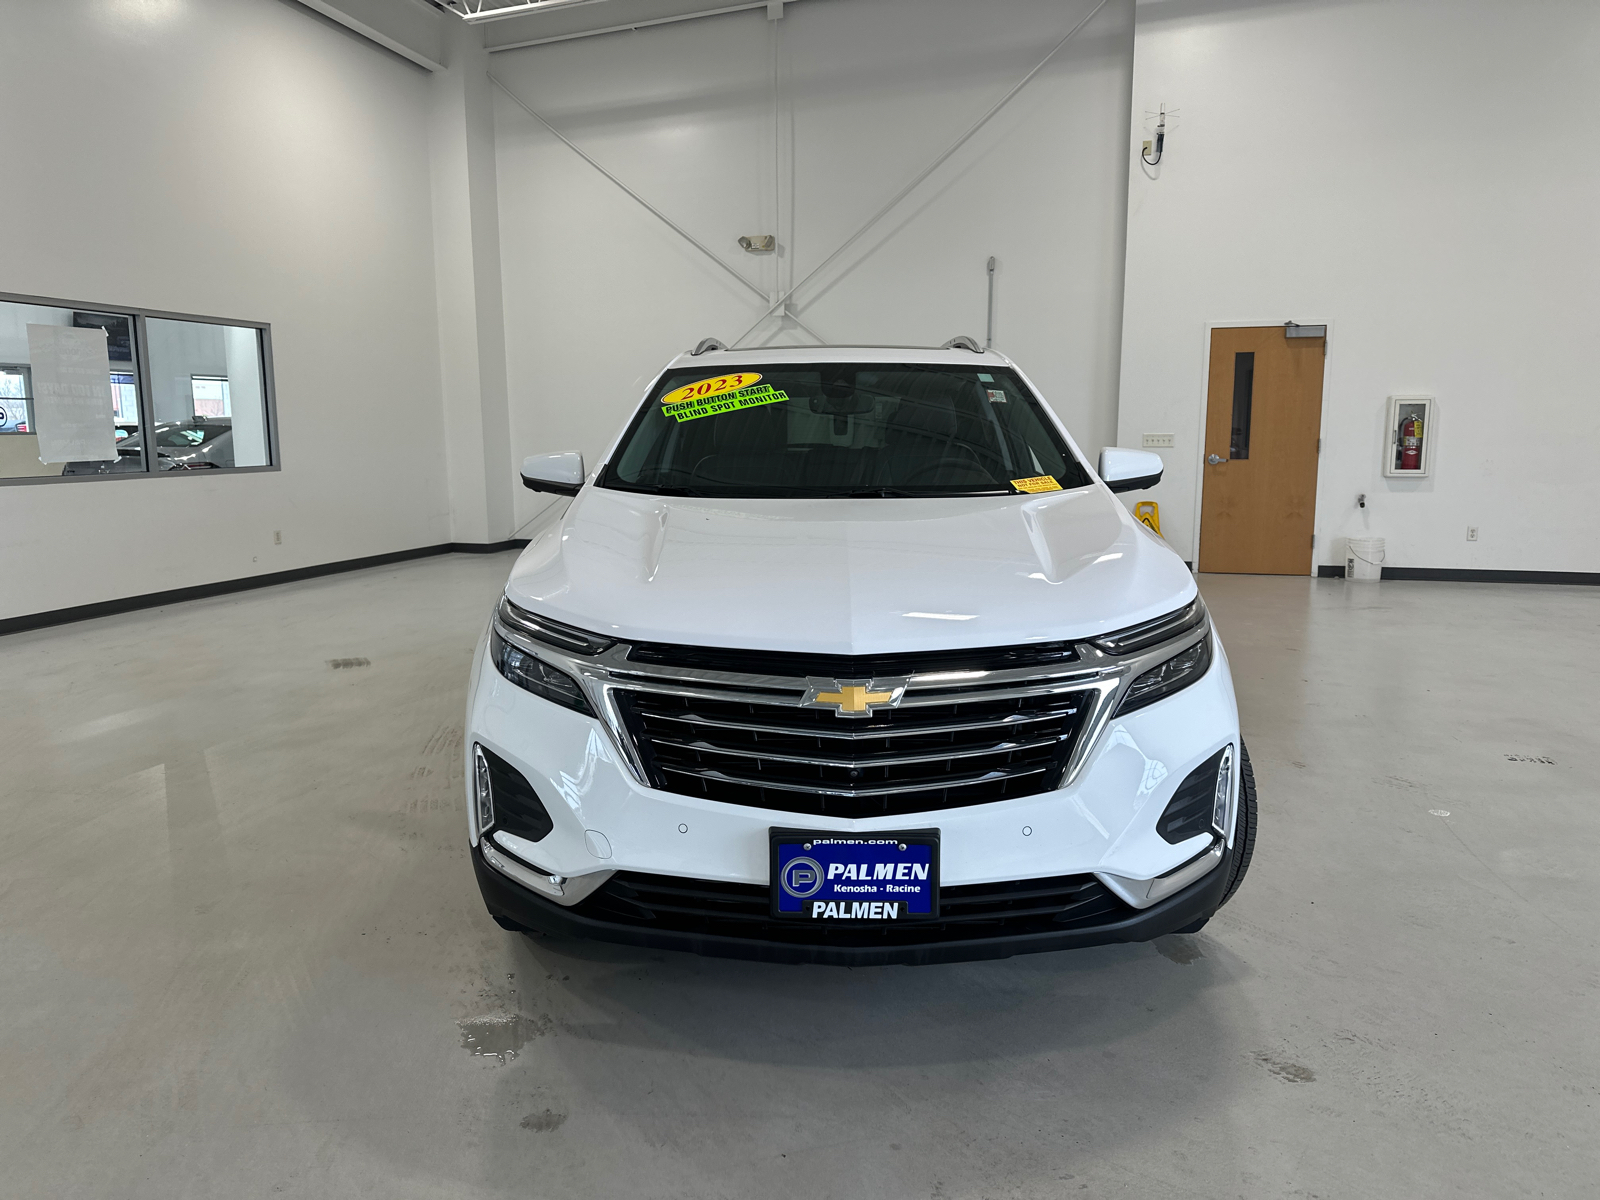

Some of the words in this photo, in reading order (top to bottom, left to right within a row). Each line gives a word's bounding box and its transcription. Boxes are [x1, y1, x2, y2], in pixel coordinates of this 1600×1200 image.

[681, 375, 743, 400] 2023
[665, 401, 694, 414] PUSH
[697, 390, 738, 407] BUTTON
[738, 385, 770, 398] START
[676, 407, 708, 420] BLIND
[712, 402, 737, 412] SPOT
[739, 392, 787, 407] MONITOR
[813, 838, 898, 846] palmen.com
[792, 869, 816, 887] P
[827, 863, 930, 881] PALMEN
[833, 884, 878, 893] Kenosha
[886, 884, 921, 893] Racine
[812, 901, 899, 919] PALMEN
